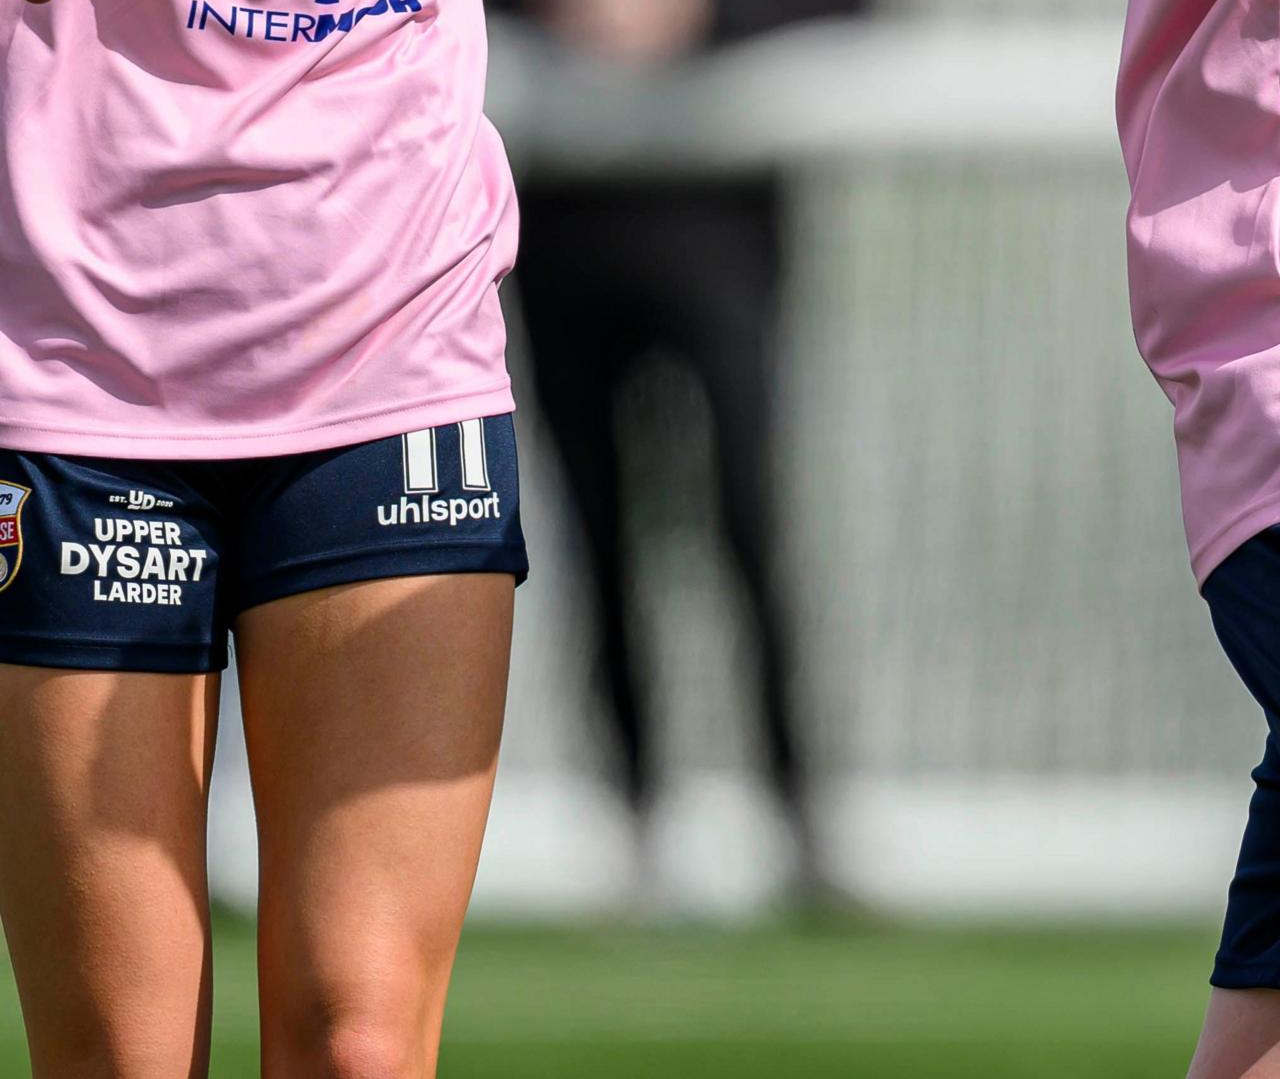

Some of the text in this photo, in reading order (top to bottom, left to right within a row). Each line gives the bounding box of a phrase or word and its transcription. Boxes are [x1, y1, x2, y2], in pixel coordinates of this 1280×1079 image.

[0, 493, 13, 505] 79
[128, 490, 156, 510] UD
[377, 492, 501, 526] uhlsport
[94, 518, 182, 545] UPPER
[60, 541, 207, 582] DYSART
[93, 580, 182, 605] LARDER
